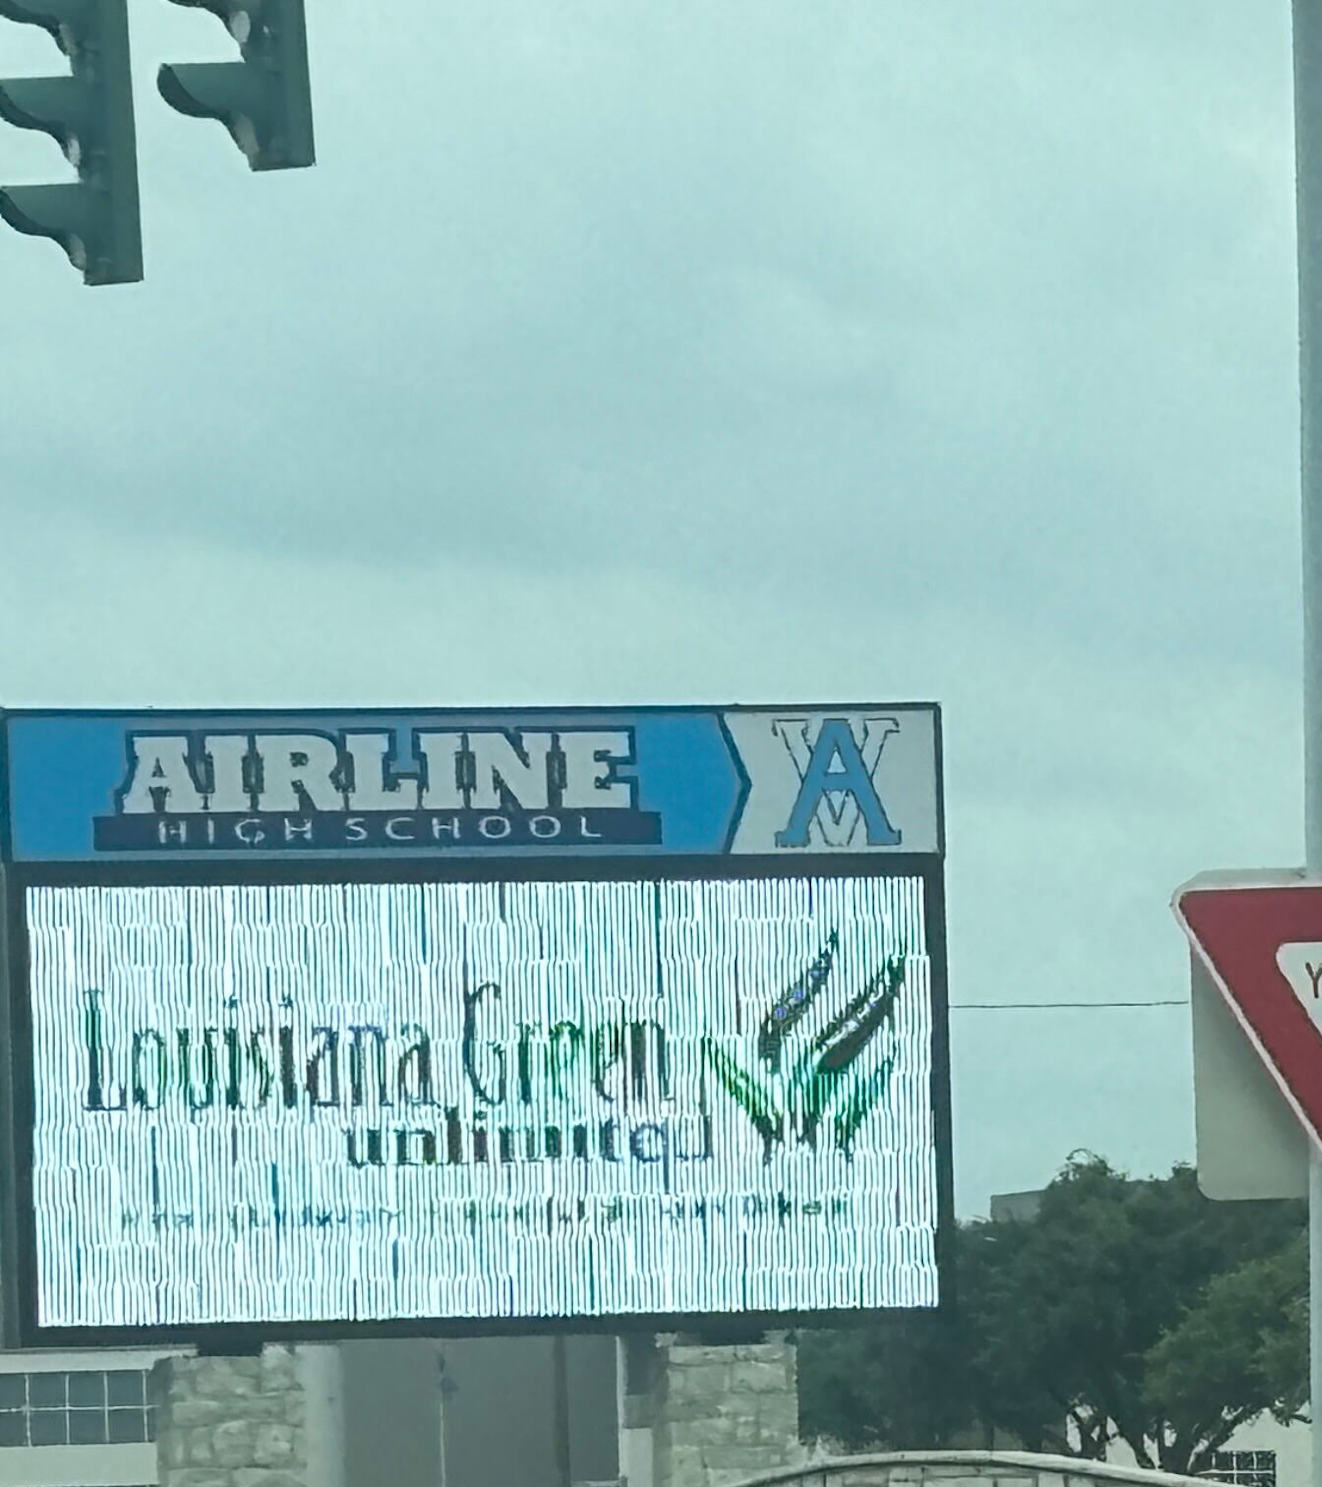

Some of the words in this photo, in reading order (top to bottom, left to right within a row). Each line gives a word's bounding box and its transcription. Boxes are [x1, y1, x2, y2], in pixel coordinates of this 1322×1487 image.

[118, 728, 635, 812] AIRLINE
[157, 817, 313, 845] HIGH
[344, 815, 603, 841] SCHOOL
[82, 988, 442, 1113] Louisiana
[462, 980, 676, 1112] Green
[340, 1104, 714, 1167] unlimited
